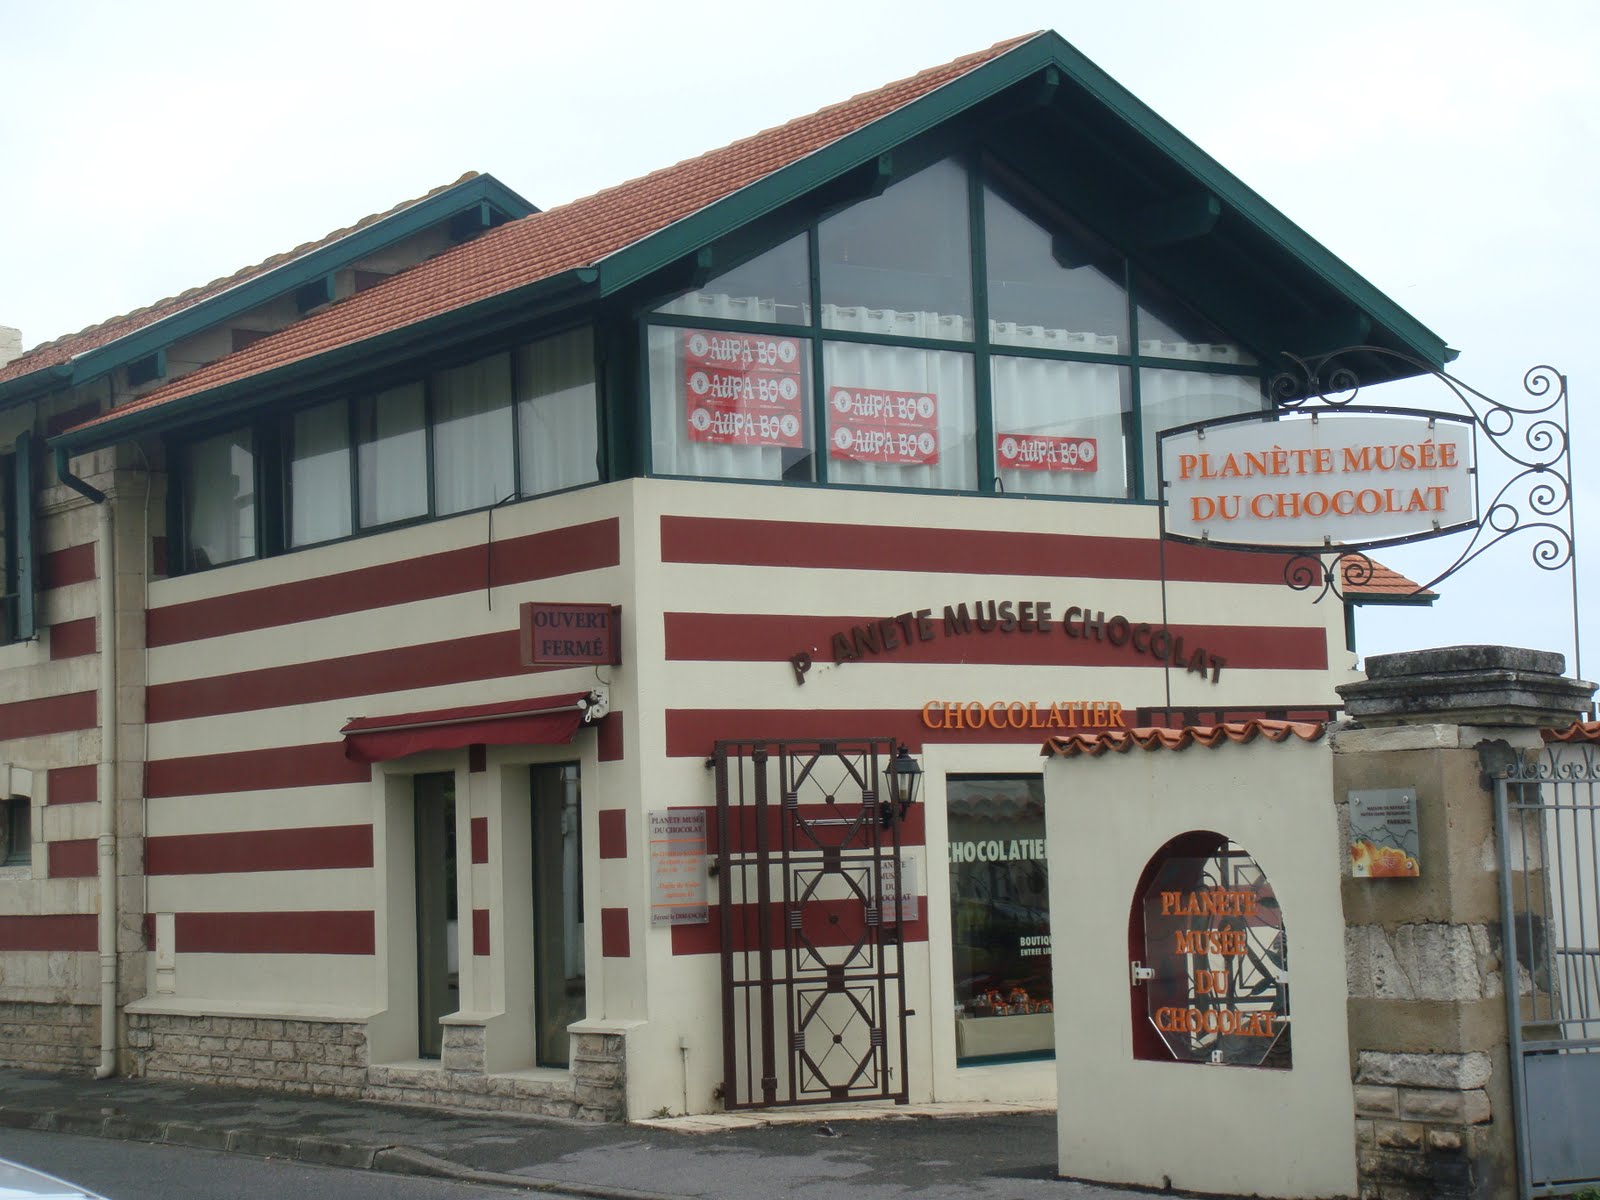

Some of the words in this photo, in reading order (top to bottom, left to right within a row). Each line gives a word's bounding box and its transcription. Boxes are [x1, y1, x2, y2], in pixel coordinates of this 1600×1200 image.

[1178, 444, 1335, 480] PLANÈTE
[1341, 438, 1460, 473] MUSÉE
[1190, 494, 1242, 522] DU
[1250, 485, 1450, 520] CHOCOLAT
[533, 610, 609, 629] OUVERT
[542, 636, 604, 657] FERMÉ
[943, 599, 1052, 638] MUSEE
[1063, 605, 1228, 684] CHOCOLAT
[922, 700, 1126, 730] CHOCOLATIER
[665, 825, 703, 834] CHOCOLAT
[948, 839, 1047, 863] HOCOLATIE
[1160, 887, 1257, 916] PLANÈTE
[1175, 924, 1248, 955] MUSÉE
[1197, 970, 1230, 994] DU
[1155, 1007, 1277, 1037] CHOCOLAT
